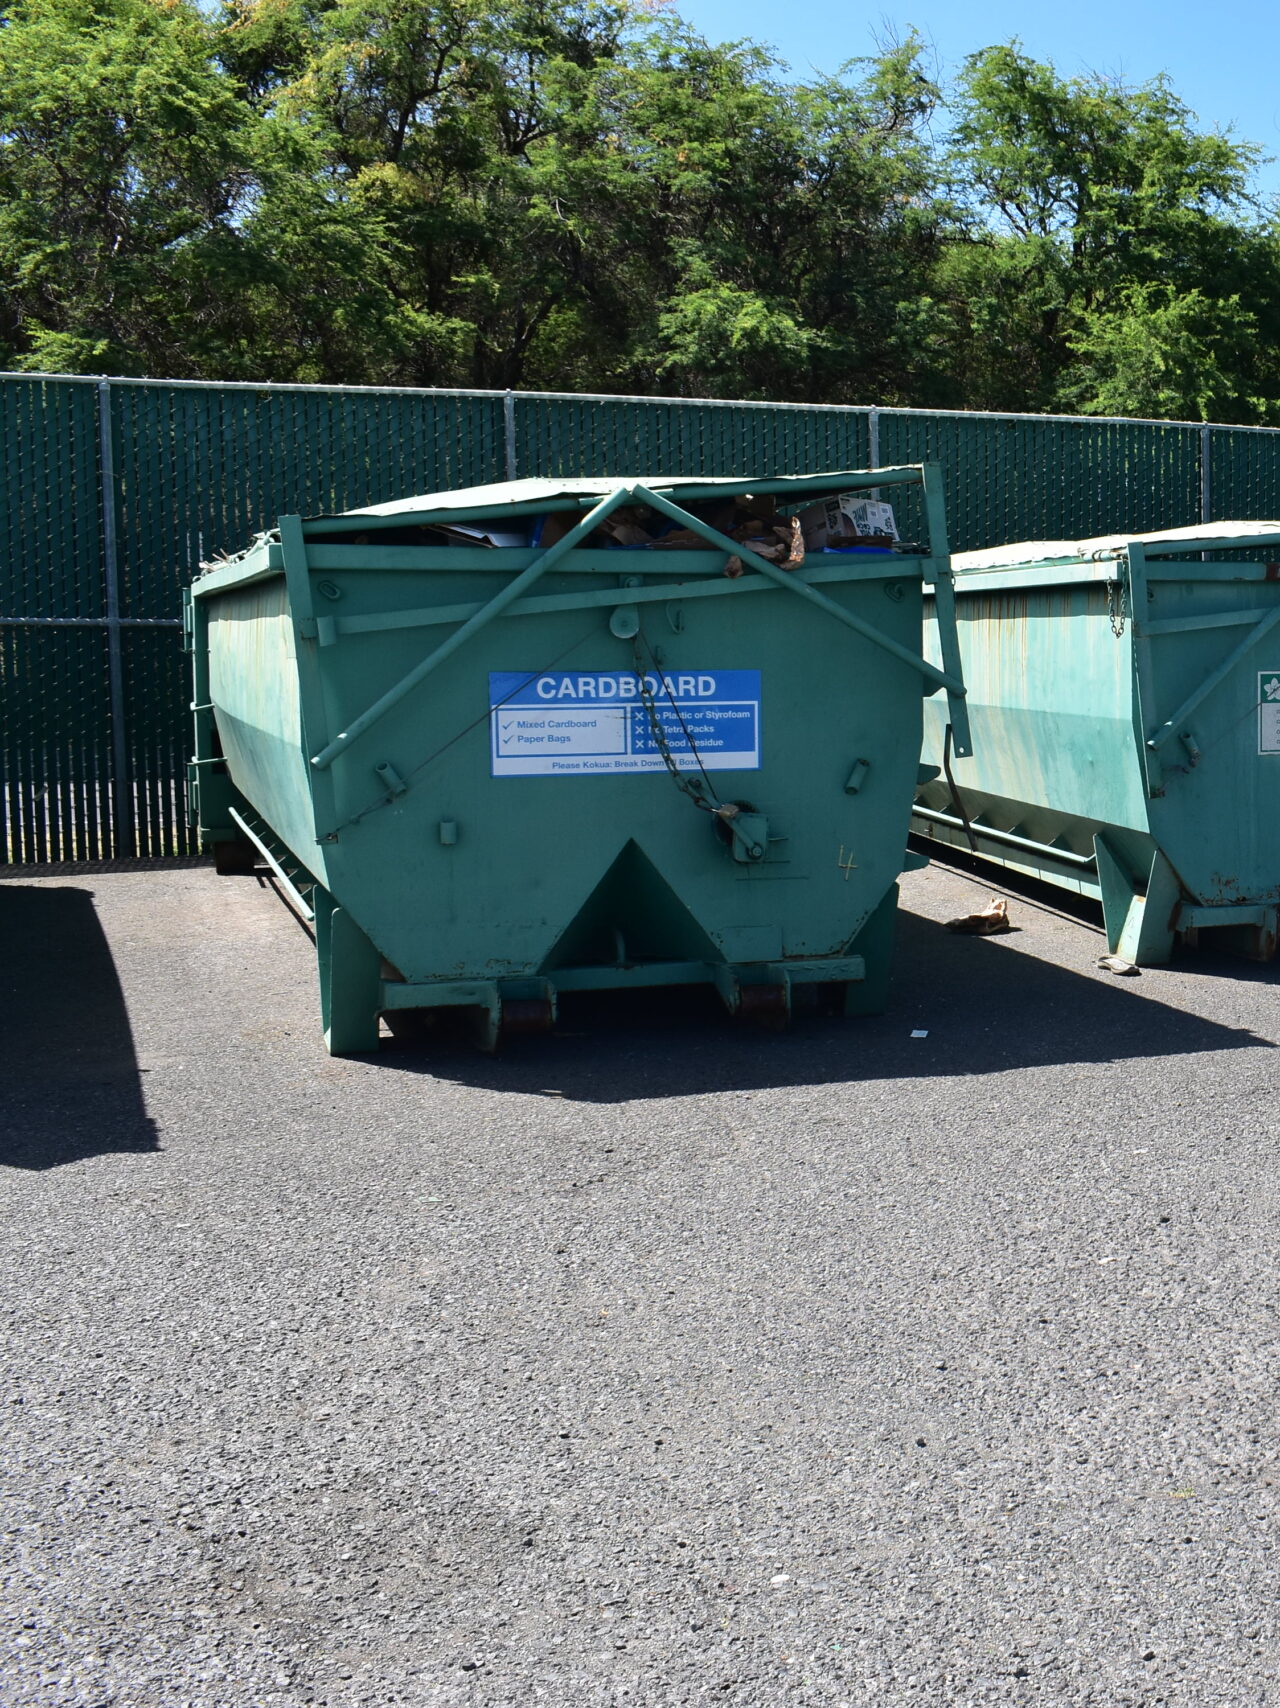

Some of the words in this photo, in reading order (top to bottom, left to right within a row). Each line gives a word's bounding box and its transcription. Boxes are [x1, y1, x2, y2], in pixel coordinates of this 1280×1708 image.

[537, 676, 716, 698] CARDBOARD
[705, 711, 751, 720] Styrofoam
[517, 720, 545, 728] Mixed
[547, 720, 597, 728] Cardboard
[663, 725, 685, 733] Tetra
[687, 725, 715, 733] Packs
[517, 735, 545, 744] Paper
[547, 735, 571, 744] Bags
[663, 739, 686, 748] Food
[583, 761, 612, 769] Kokua:
